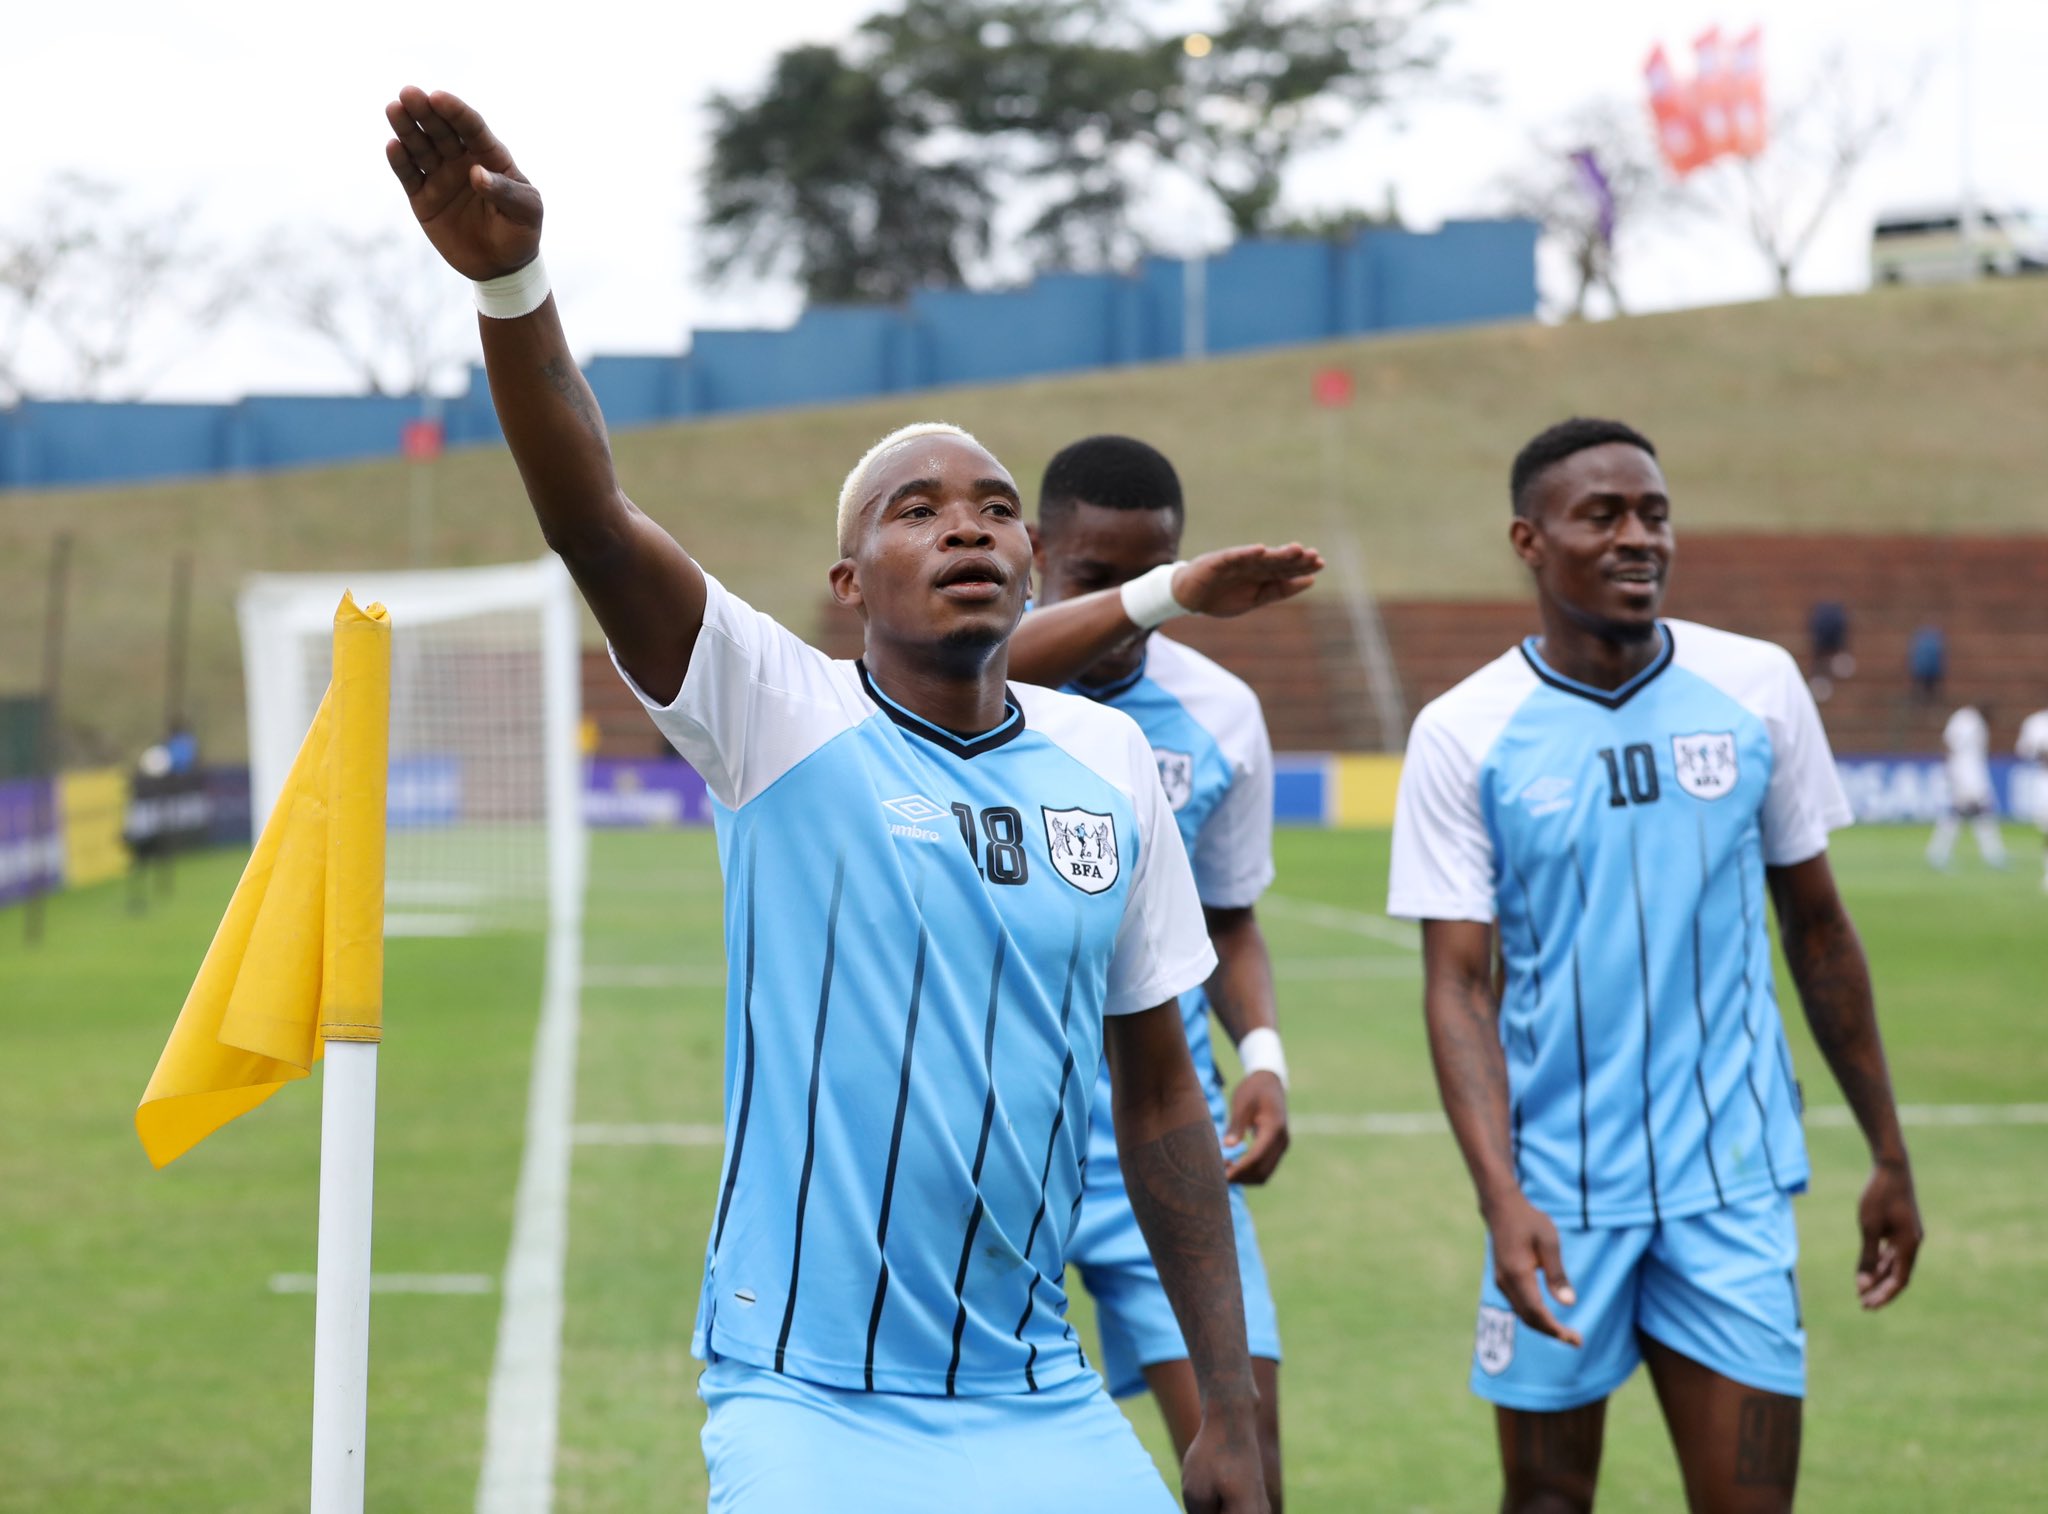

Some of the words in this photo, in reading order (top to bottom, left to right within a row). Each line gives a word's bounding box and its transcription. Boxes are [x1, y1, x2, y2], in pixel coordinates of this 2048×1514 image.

[1597, 743, 1661, 808] 10
[951, 801, 1029, 885] 18
[1070, 862, 1104, 880] BFA
